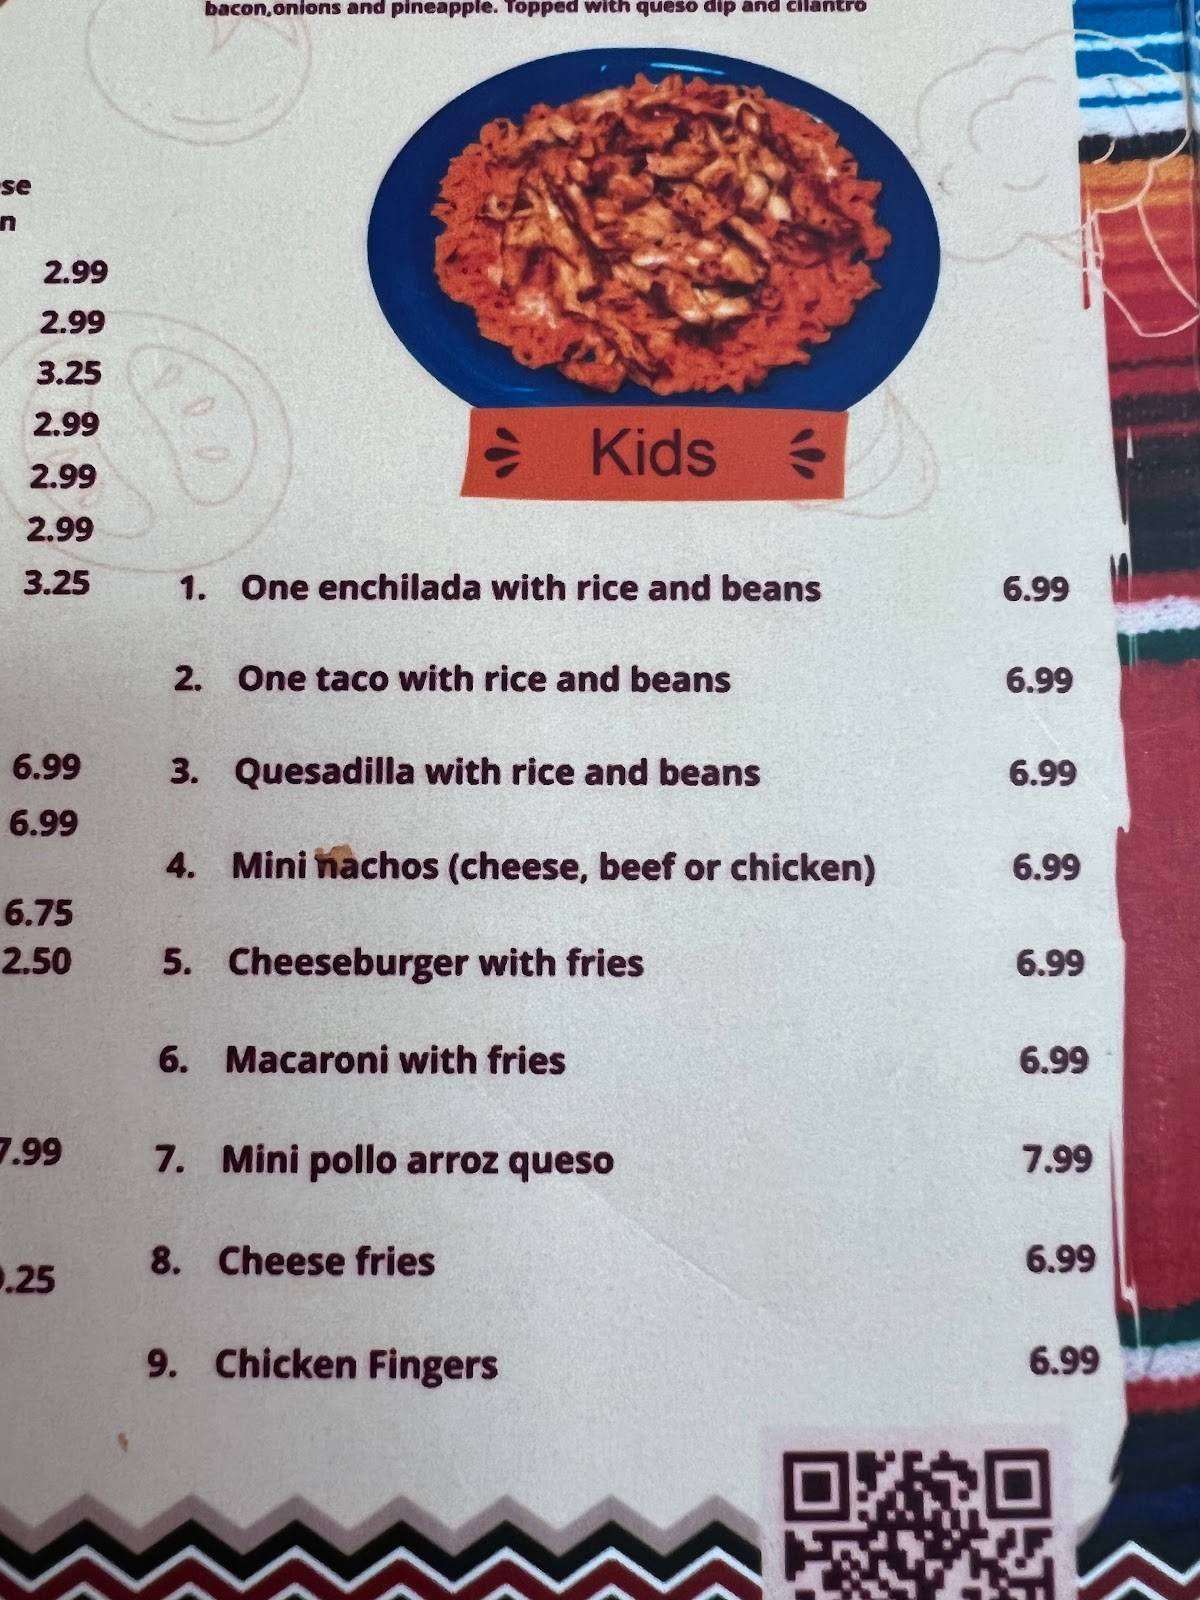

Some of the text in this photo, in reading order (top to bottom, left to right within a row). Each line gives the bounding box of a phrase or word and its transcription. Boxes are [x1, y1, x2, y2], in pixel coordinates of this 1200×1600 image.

[346, 0, 387, 15] and
[391, 0, 498, 19] pineapple.
[503, 0, 579, 18] Topped
[583, 0, 631, 14] with
[635, 0, 699, 18] queso
[703, 0, 737, 18] dip
[741, 0, 781, 13] and
[785, 0, 868, 13] cilantro
[43, 260, 108, 284] 2.99
[40, 309, 105, 334] 2.99
[36, 360, 101, 385] 3.25
[33, 411, 100, 437] 2.99
[593, 428, 717, 477] Kids
[30, 463, 97, 489] 2.99
[27, 516, 94, 542] 2.99
[23, 570, 90, 595] 3.25
[180, 573, 1070, 602] 1. One enchilada with rice and beans 6.99
[174, 664, 1074, 694] 2. One taco with rice and beans 6.99
[12, 753, 81, 780] 6.99
[170, 756, 1077, 790] 3. Quesadilla with rice and beans 6.99
[9, 809, 78, 837] 6.99
[166, 850, 1081, 887] 4. Mini nachos (cheese, beef or chicken) 6.99
[4, 898, 73, 926] 6.75
[2, 947, 72, 975] 2.50
[163, 946, 1085, 985] 5. Cheeseburger with fries 6.99
[159, 1044, 1089, 1075] 6. Macaroni with fries 6.99
[155, 1143, 1093, 1184] 7. Mini pollo arroz queso 7.99
[151, 1244, 1096, 1277] 8. Cheese fries 6.99
[0, 1264, 55, 1294] .25
[147, 1345, 1100, 1389] 9. Chicken Fingers 6.99
